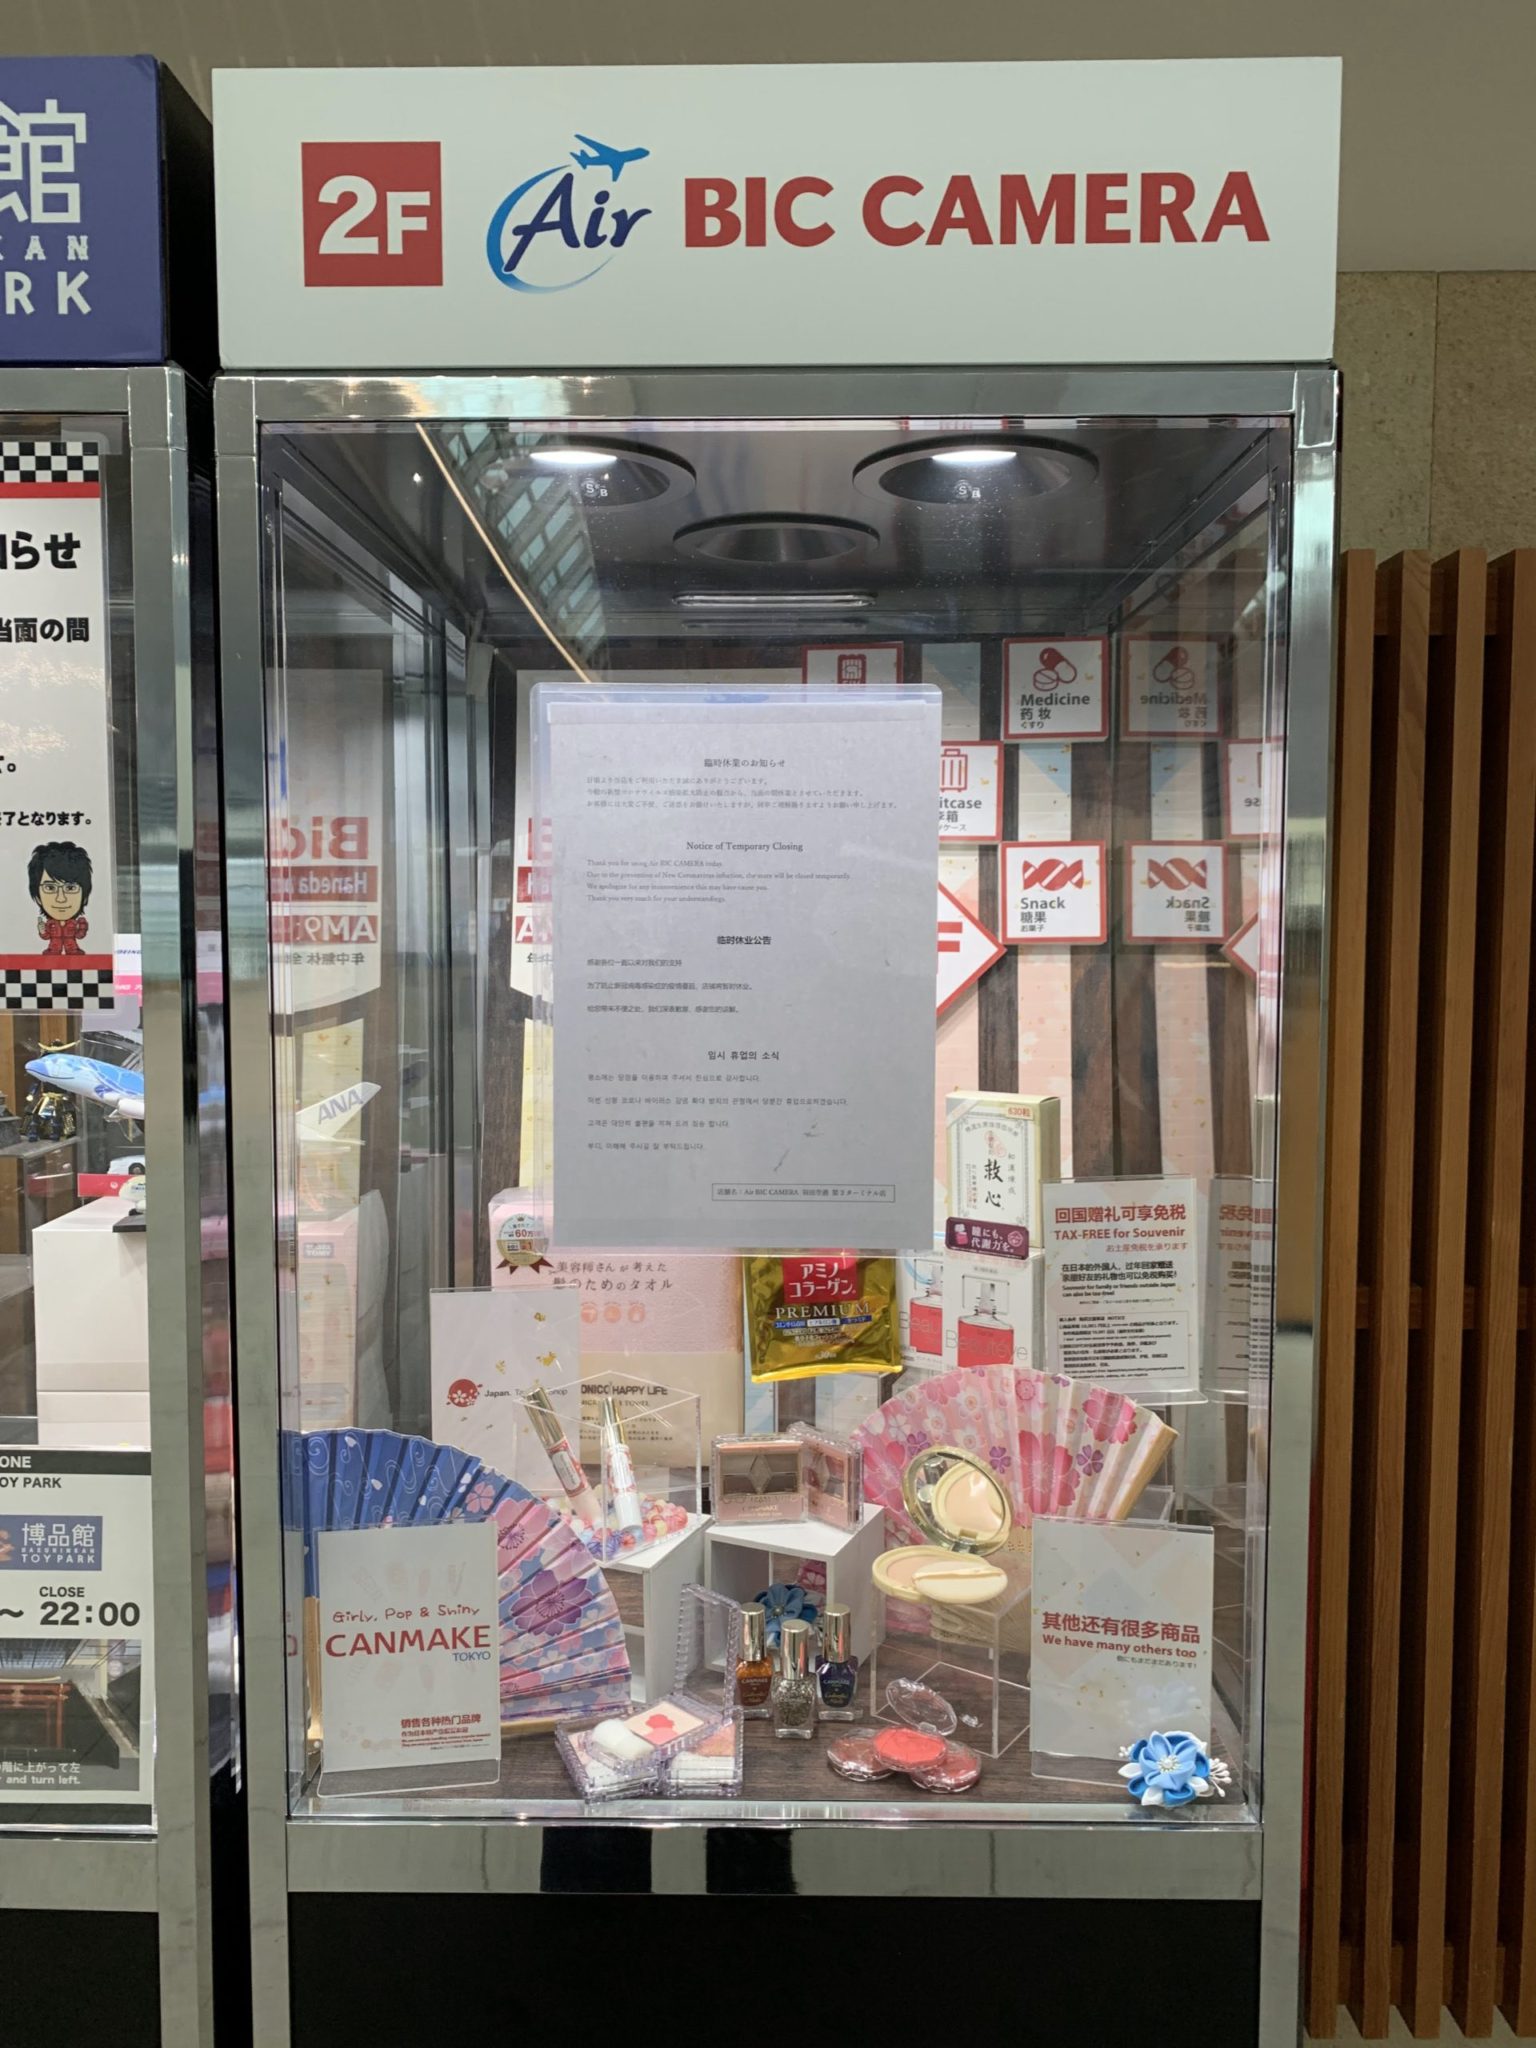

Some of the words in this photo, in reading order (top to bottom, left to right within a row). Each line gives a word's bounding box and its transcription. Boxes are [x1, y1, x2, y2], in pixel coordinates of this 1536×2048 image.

[318, 175, 431, 255] 2F
[503, 172, 652, 272] Air
[684, 176, 836, 248] BIC
[862, 171, 1270, 247] CAMERA
[0, 531, 81, 570] らせ
[1020, 693, 1090, 706] Medicine
[704, 758, 785, 767] 臨時休業のお知らせ
[0, 811, 91, 826] 了となります。
[686, 841, 713, 850] Notice
[715, 841, 724, 850] of
[726, 842, 770, 852] Temporary
[772, 842, 804, 852] Closing
[1020, 897, 1065, 909] Snack
[717, 936, 771, 945] 临时休业公告
[730, 1051, 757, 1060] 휴업의
[762, 1051, 779, 1060] 소식
[1055, 1203, 1186, 1223] 回国赠礼可享免税
[1054, 1229, 1110, 1240] TAX-FREE
[1113, 1228, 1131, 1238] for
[1133, 1226, 1186, 1238] Souvenir
[801, 1262, 839, 1279] アミノ
[788, 1279, 853, 1298] コラーゲン
[776, 1303, 869, 1319] PREMIUM
[612, 1386, 645, 1395] HAPPY
[647, 1387, 668, 1395] LIFE
[23, 1477, 62, 1488] PARK
[22, 1522, 96, 1547] 博品館
[21, 1554, 52, 1563] TOY
[57, 1554, 95, 1563] PARK
[39, 1586, 85, 1598] CLOSE
[40, 1601, 141, 1627] 22:00
[385, 1608, 413, 1620] Pop
[419, 1607, 430, 1617] &
[1042, 1611, 1201, 1644] 其他还有很多商品
[325, 1625, 491, 1657] CANMAKE
[1042, 1634, 1062, 1645] We
[1064, 1636, 1094, 1648] have
[1096, 1641, 1130, 1654] many
[1133, 1644, 1173, 1656] others
[1175, 1648, 1197, 1658] too
[452, 1651, 491, 1662] TOKYO
[0, 1761, 80, 1773] 階に上がって左
[6, 1775, 27, 1784] and
[31, 1776, 55, 1784] turn
